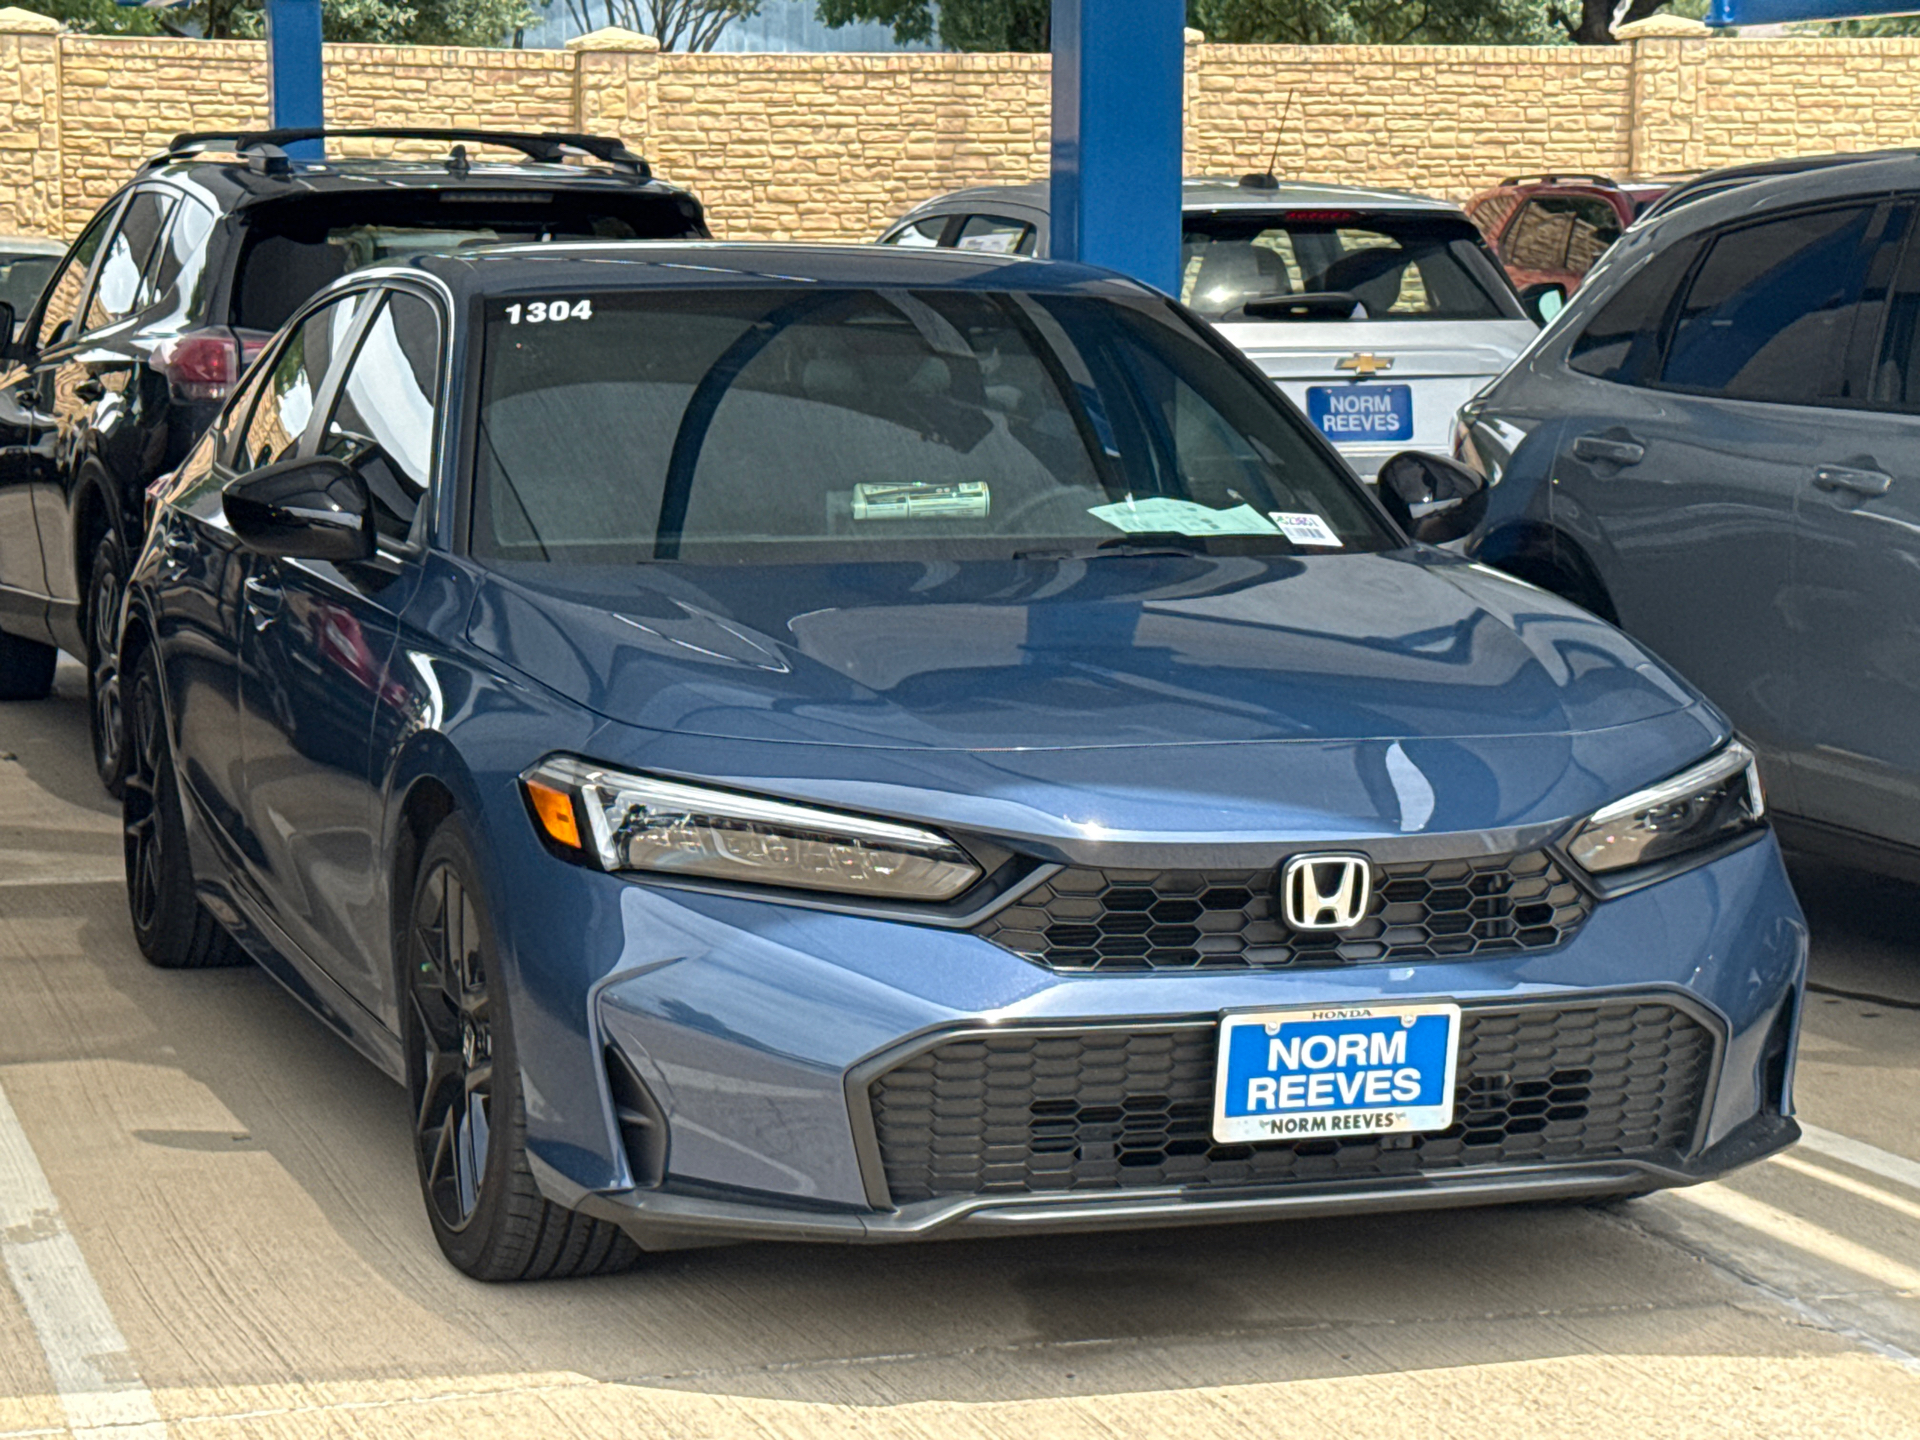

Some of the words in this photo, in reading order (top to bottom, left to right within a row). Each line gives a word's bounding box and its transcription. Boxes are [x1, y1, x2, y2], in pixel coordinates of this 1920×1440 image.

[505, 299, 592, 325] 1304
[1329, 395, 1391, 413] NORM
[1322, 413, 1400, 432] REEVES
[1312, 1009, 1372, 1020] HONDA
[1267, 1031, 1407, 1071] NORM
[1247, 1068, 1421, 1111] REEVES
[1270, 1118, 1327, 1134] NORM
[1331, 1112, 1395, 1130] REEVES
